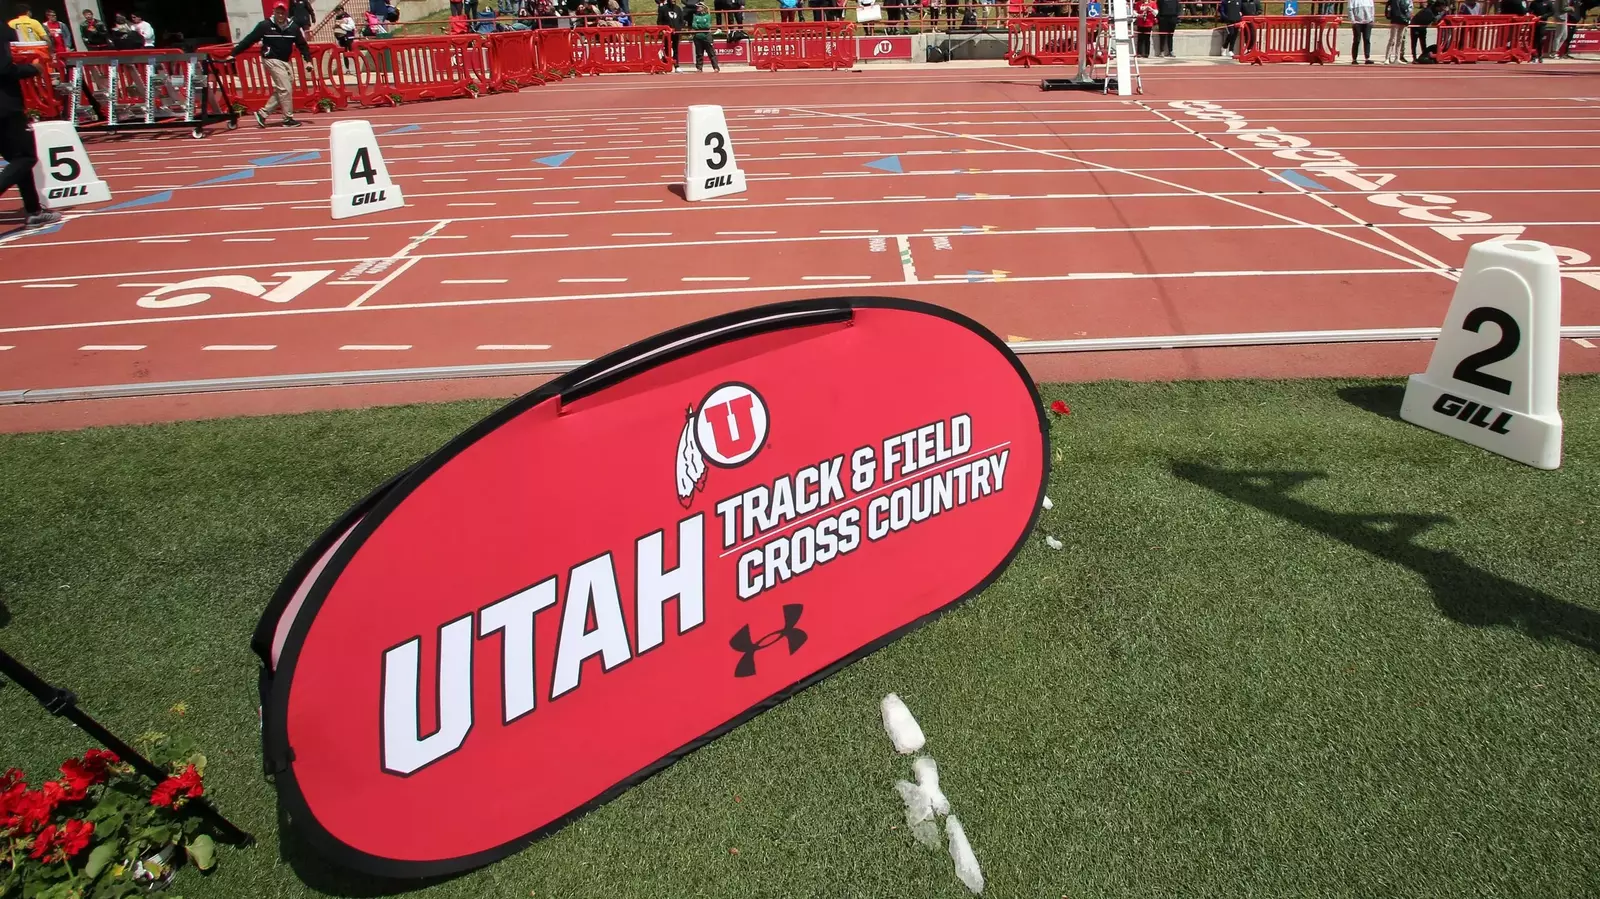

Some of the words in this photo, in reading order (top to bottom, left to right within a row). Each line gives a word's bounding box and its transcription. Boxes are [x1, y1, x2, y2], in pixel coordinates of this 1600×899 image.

[48, 145, 81, 182] 5
[349, 147, 378, 185] 4
[704, 132, 728, 170] 3
[48, 185, 89, 199] GILL
[351, 190, 387, 206] GILL
[704, 174, 733, 190] GILL
[1366, 193, 1493, 223] 3
[1452, 306, 1521, 396] 2
[703, 393, 755, 460] U
[1432, 393, 1513, 435] GILL
[716, 453, 845, 549] TRACK
[851, 444, 876, 493] &
[882, 412, 972, 482] FIELD
[737, 506, 860, 601] CROSS
[866, 449, 1010, 542] COUNTRY
[380, 510, 705, 778] UTAH
